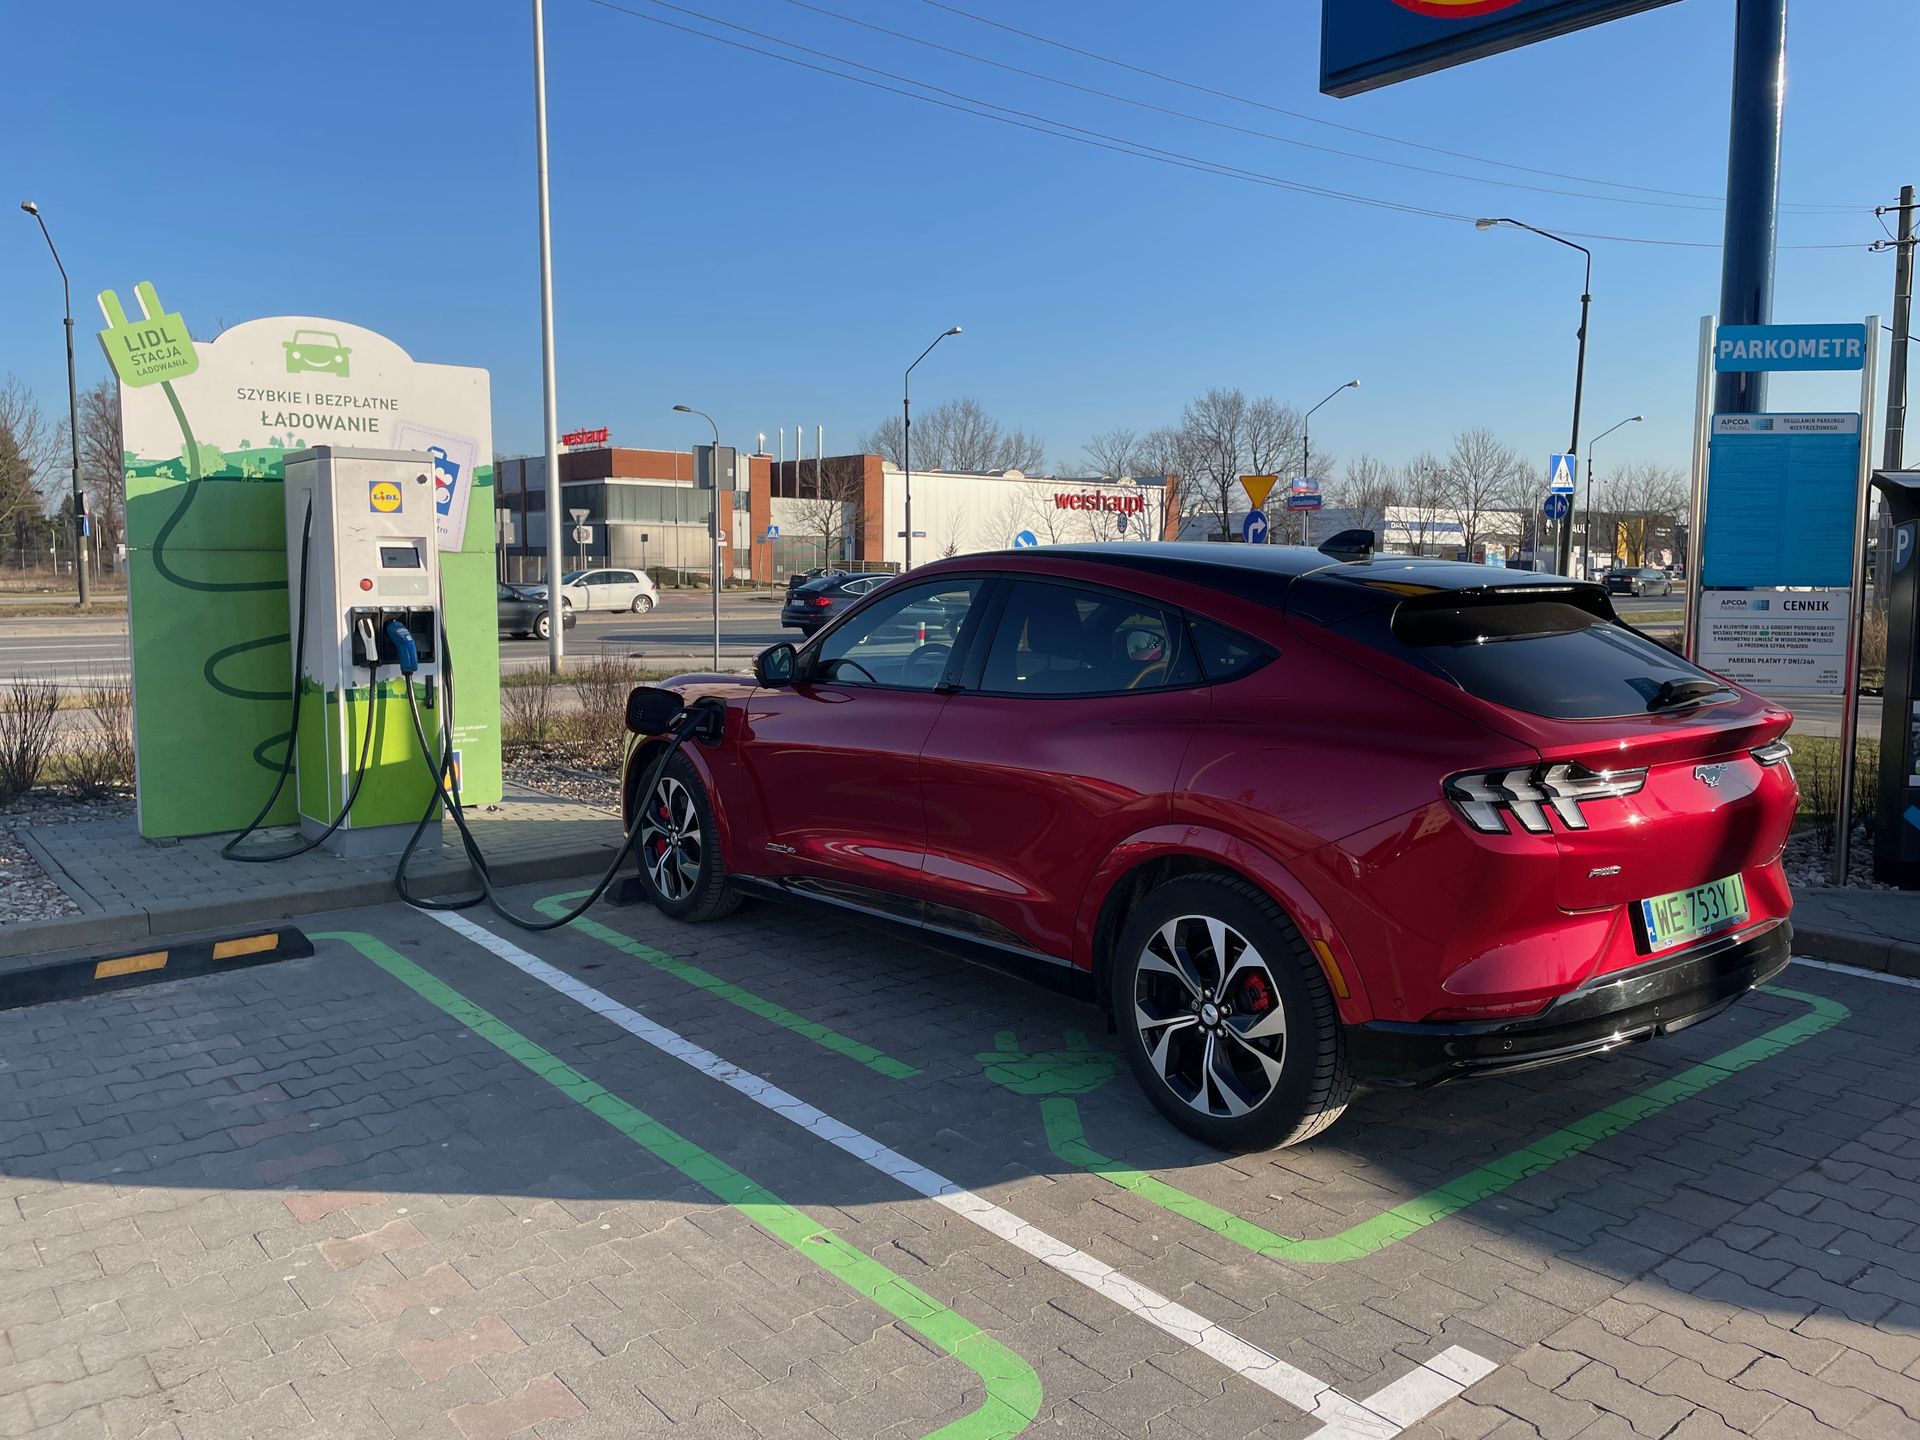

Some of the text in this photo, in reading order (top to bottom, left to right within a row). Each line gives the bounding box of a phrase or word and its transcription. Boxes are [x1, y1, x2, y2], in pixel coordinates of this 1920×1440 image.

[123, 327, 176, 352] LIDL
[1719, 338, 1860, 359] PARKOMETR
[131, 346, 181, 366] STACJA
[136, 358, 188, 376] ŁADOWANIA
[237, 388, 399, 411] SZYBKIE I BEZPŁATNE
[261, 411, 379, 433] ŁADOWANIE
[1054, 489, 1145, 518] weishaupt
[1896, 529, 1909, 563] P
[1783, 600, 1830, 611] CENNIK
[1655, 879, 1740, 936] WE 753YJ
